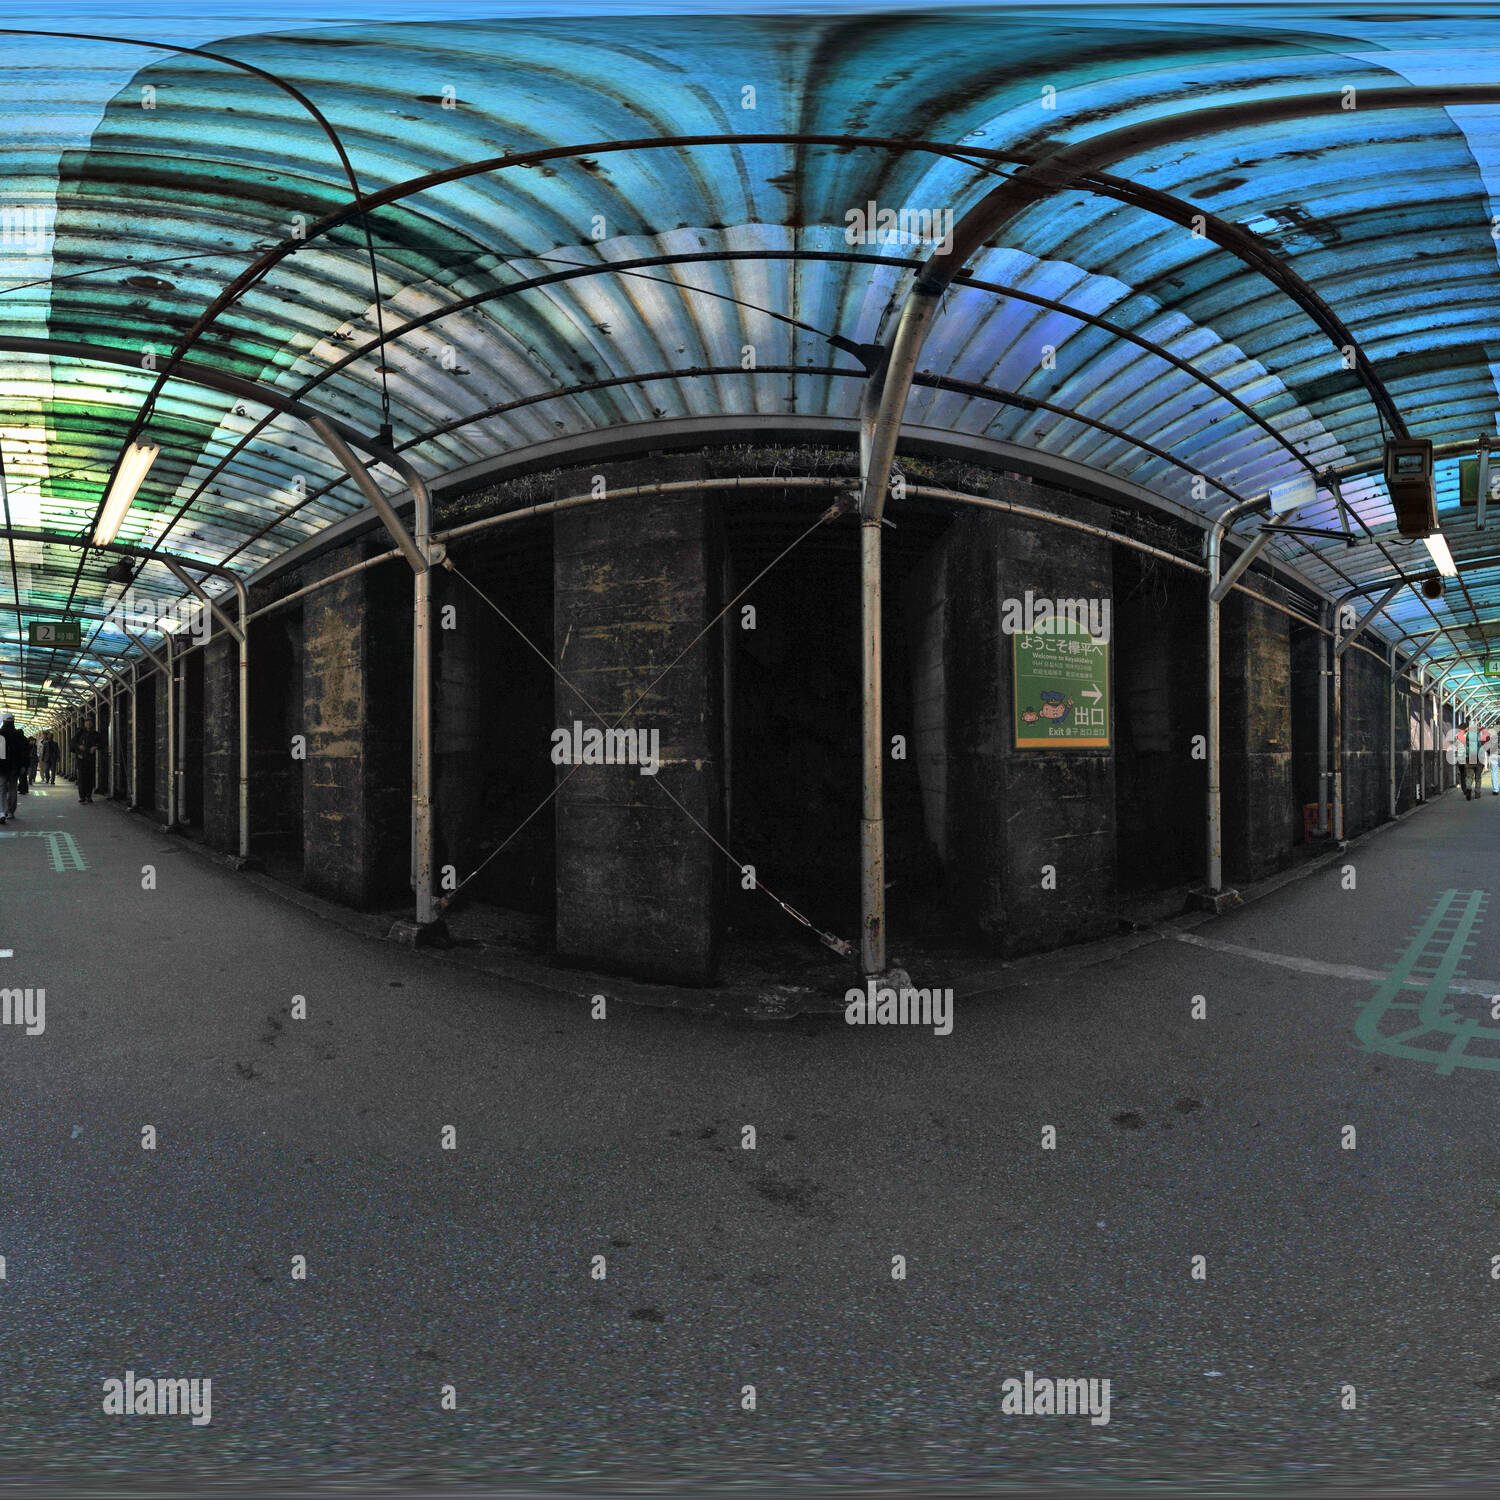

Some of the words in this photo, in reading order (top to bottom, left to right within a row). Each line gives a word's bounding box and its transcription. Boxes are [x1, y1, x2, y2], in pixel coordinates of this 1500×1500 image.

[41, 627, 50, 639] 2
[1032, 652, 1057, 661] Welcome
[1492, 662, 1499, 671] 4
[1074, 706, 1104, 726] 出口
[1049, 727, 1064, 736] Exit
